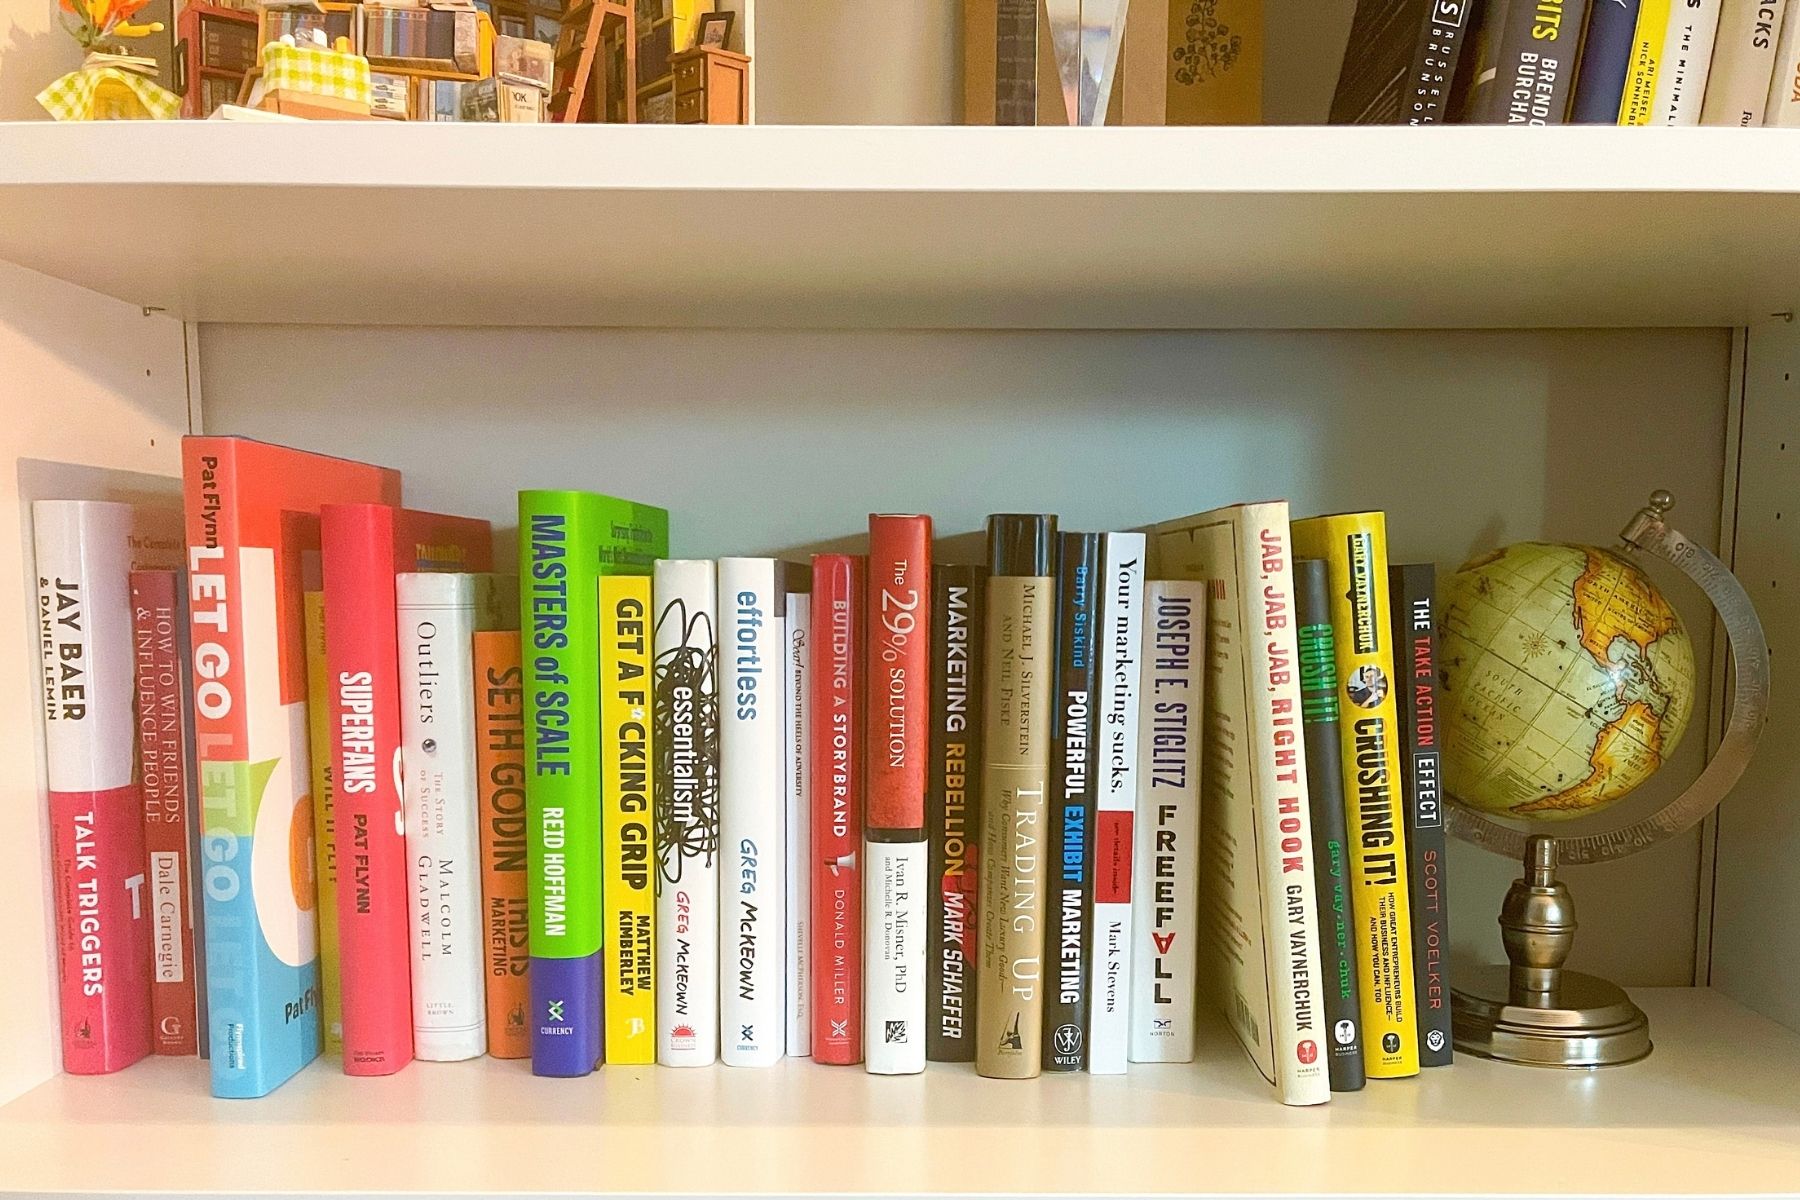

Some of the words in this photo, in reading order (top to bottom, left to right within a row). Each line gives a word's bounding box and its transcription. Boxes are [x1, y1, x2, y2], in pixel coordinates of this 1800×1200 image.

[1638, 41, 1650, 66] NICK
[1682, 25, 1693, 52] THE
[1410, 28, 1441, 126] BRUNSON
[1424, 31, 1454, 122] RUSSELL
[1647, 58, 1655, 76] ARI
[1639, 81, 1651, 118] MEISEL
[202, 456, 219, 491] Pat
[202, 493, 221, 549] Flynn
[894, 558, 908, 586] The
[1259, 528, 1283, 581] JAB,
[1352, 537, 1368, 567] GARY
[40, 576, 50, 589] &
[55, 577, 82, 632] JAY
[190, 547, 228, 632] LET
[532, 515, 569, 649] MASTERS
[1073, 566, 1089, 606] Barry
[1117, 557, 1138, 610] Your
[41, 595, 54, 660] DANIEL
[137, 606, 151, 621] &
[157, 606, 172, 654] HOW
[616, 598, 644, 655] GET
[881, 587, 919, 663] 29%
[1002, 613, 1012, 643] AND
[1021, 584, 1036, 651] MICHAEL
[1156, 595, 1191, 671] JOSEPH
[1264, 585, 1287, 637] JAB,
[1354, 572, 1375, 652] VAYNERCHUK
[1413, 598, 1431, 631] THE
[737, 591, 763, 721] effortless
[834, 600, 847, 689] BUILDING
[947, 586, 968, 733] MARKETING
[1001, 649, 1014, 683] NEIL
[1019, 655, 1034, 667] J.
[1073, 611, 1086, 669] Siskind
[1298, 623, 1338, 692] CRUSH
[1415, 636, 1434, 679] TAKE
[46, 666, 57, 721] LEMIN
[59, 643, 87, 722] BAER
[139, 630, 158, 742] INFLUENCE
[160, 663, 174, 694] TO
[197, 642, 232, 720] GO
[416, 621, 439, 724] Outliers
[535, 656, 569, 685] of
[619, 661, 645, 681] A
[795, 670, 803, 702] BEYOND
[1107, 616, 1133, 726] marketing
[1155, 678, 1188, 695] E.
[1267, 641, 1292, 693] JAB,
[161, 697, 177, 733] WIN
[487, 666, 524, 751] SETH
[795, 704, 803, 719] THE
[834, 695, 846, 708] A
[890, 667, 906, 769] SOLUTION
[1000, 688, 1013, 727] FISKE
[1019, 671, 1034, 756] SILVERSTEIN
[1304, 695, 1339, 725] IT!
[1416, 685, 1435, 747] ACTION
[339, 671, 376, 793] SUPERFANS
[536, 691, 571, 776] SCALE
[673, 686, 699, 823] essentialism
[795, 721, 803, 743] HEELS
[1065, 690, 1088, 799] POWERFUL
[1152, 702, 1188, 789] STIGLITZ
[1272, 698, 1298, 785] RIGHT
[145, 749, 161, 824] PEOPLE
[164, 740, 181, 824] FRIENDS
[795, 757, 803, 798] ADVERSITY
[834, 713, 847, 838] STORYBRAND
[1110, 731, 1130, 794] sucks.
[1354, 717, 1395, 848] CRUSHING
[1418, 757, 1438, 821] EFFECT
[491, 763, 527, 872] GODIN
[945, 743, 967, 876] REBELLION
[988, 811, 997, 830] and
[1000, 789, 1012, 811] Why
[74, 811, 97, 871] TALK
[354, 814, 369, 850] PAT
[543, 807, 565, 849] REID
[987, 832, 996, 853] How
[1064, 805, 1085, 883] EXHIBIT
[1278, 796, 1304, 874] HOOK
[157, 857, 175, 896] Dale
[206, 826, 240, 902] GO
[621, 822, 648, 891] GRIP
[739, 838, 758, 895] GREG
[885, 856, 893, 872] and
[896, 856, 908, 887] Ivan
[999, 865, 1009, 891] Want
[1013, 781, 1044, 934] TRADING
[1328, 840, 1343, 877] gary
[1364, 853, 1397, 887] IT!
[1424, 849, 1438, 913] SCOTT
[355, 856, 372, 915] FLYNN
[418, 856, 433, 962] GLADWELL
[439, 859, 454, 957] MALCOLM
[545, 853, 566, 936] HOFFMAN
[676, 890, 691, 934] GREG
[884, 874, 893, 909] Michelle
[896, 891, 908, 907] R.
[999, 893, 1008, 915] New
[1152, 805, 1178, 1005] FREEFALL
[1286, 884, 1305, 926] GARY
[1379, 897, 1387, 919] THEIR
[1388, 892, 1396, 910] HOW
[78, 878, 104, 998] TRIGGERS
[158, 902, 178, 978] Carnegie
[491, 897, 507, 977] MARKETING
[835, 889, 845, 949] DONALD
[884, 922, 893, 961] Donovan
[893, 910, 908, 961] Misner,
[944, 891, 964, 943] MARK
[985, 910, 994, 943] Create
[997, 918, 1008, 952] Luxury
[1108, 921, 1122, 957] Mark
[1370, 916, 1378, 932] AND
[1371, 934, 1380, 952] HOW
[1380, 920, 1390, 957] BUSINESS
[1390, 911, 1398, 936] GREAT
[619, 910, 635, 996] KIMBERLEY
[637, 915, 651, 991] MATTHEW
[984, 945, 993, 969] Them
[1060, 889, 1082, 1005] MARKETING
[1372, 953, 1381, 969] YOU
[1382, 958, 1391, 973] AND
[1391, 937, 1402, 1000] ENTREPRENEURS
[1427, 921, 1442, 1010] VOELKER
[834, 955, 845, 1005] MILLER
[895, 964, 907, 994] PhD
[942, 948, 964, 1039] SCHAEFER
[1012, 956, 1040, 1001] UP
[1106, 961, 1121, 1014] Stevens
[1289, 931, 1313, 1032] VAYNERCHUK
[541, 1027, 573, 1035] CURRENCY
[1395, 1001, 1403, 1023] BUILD
[1055, 1056, 1082, 1065] WILEY
